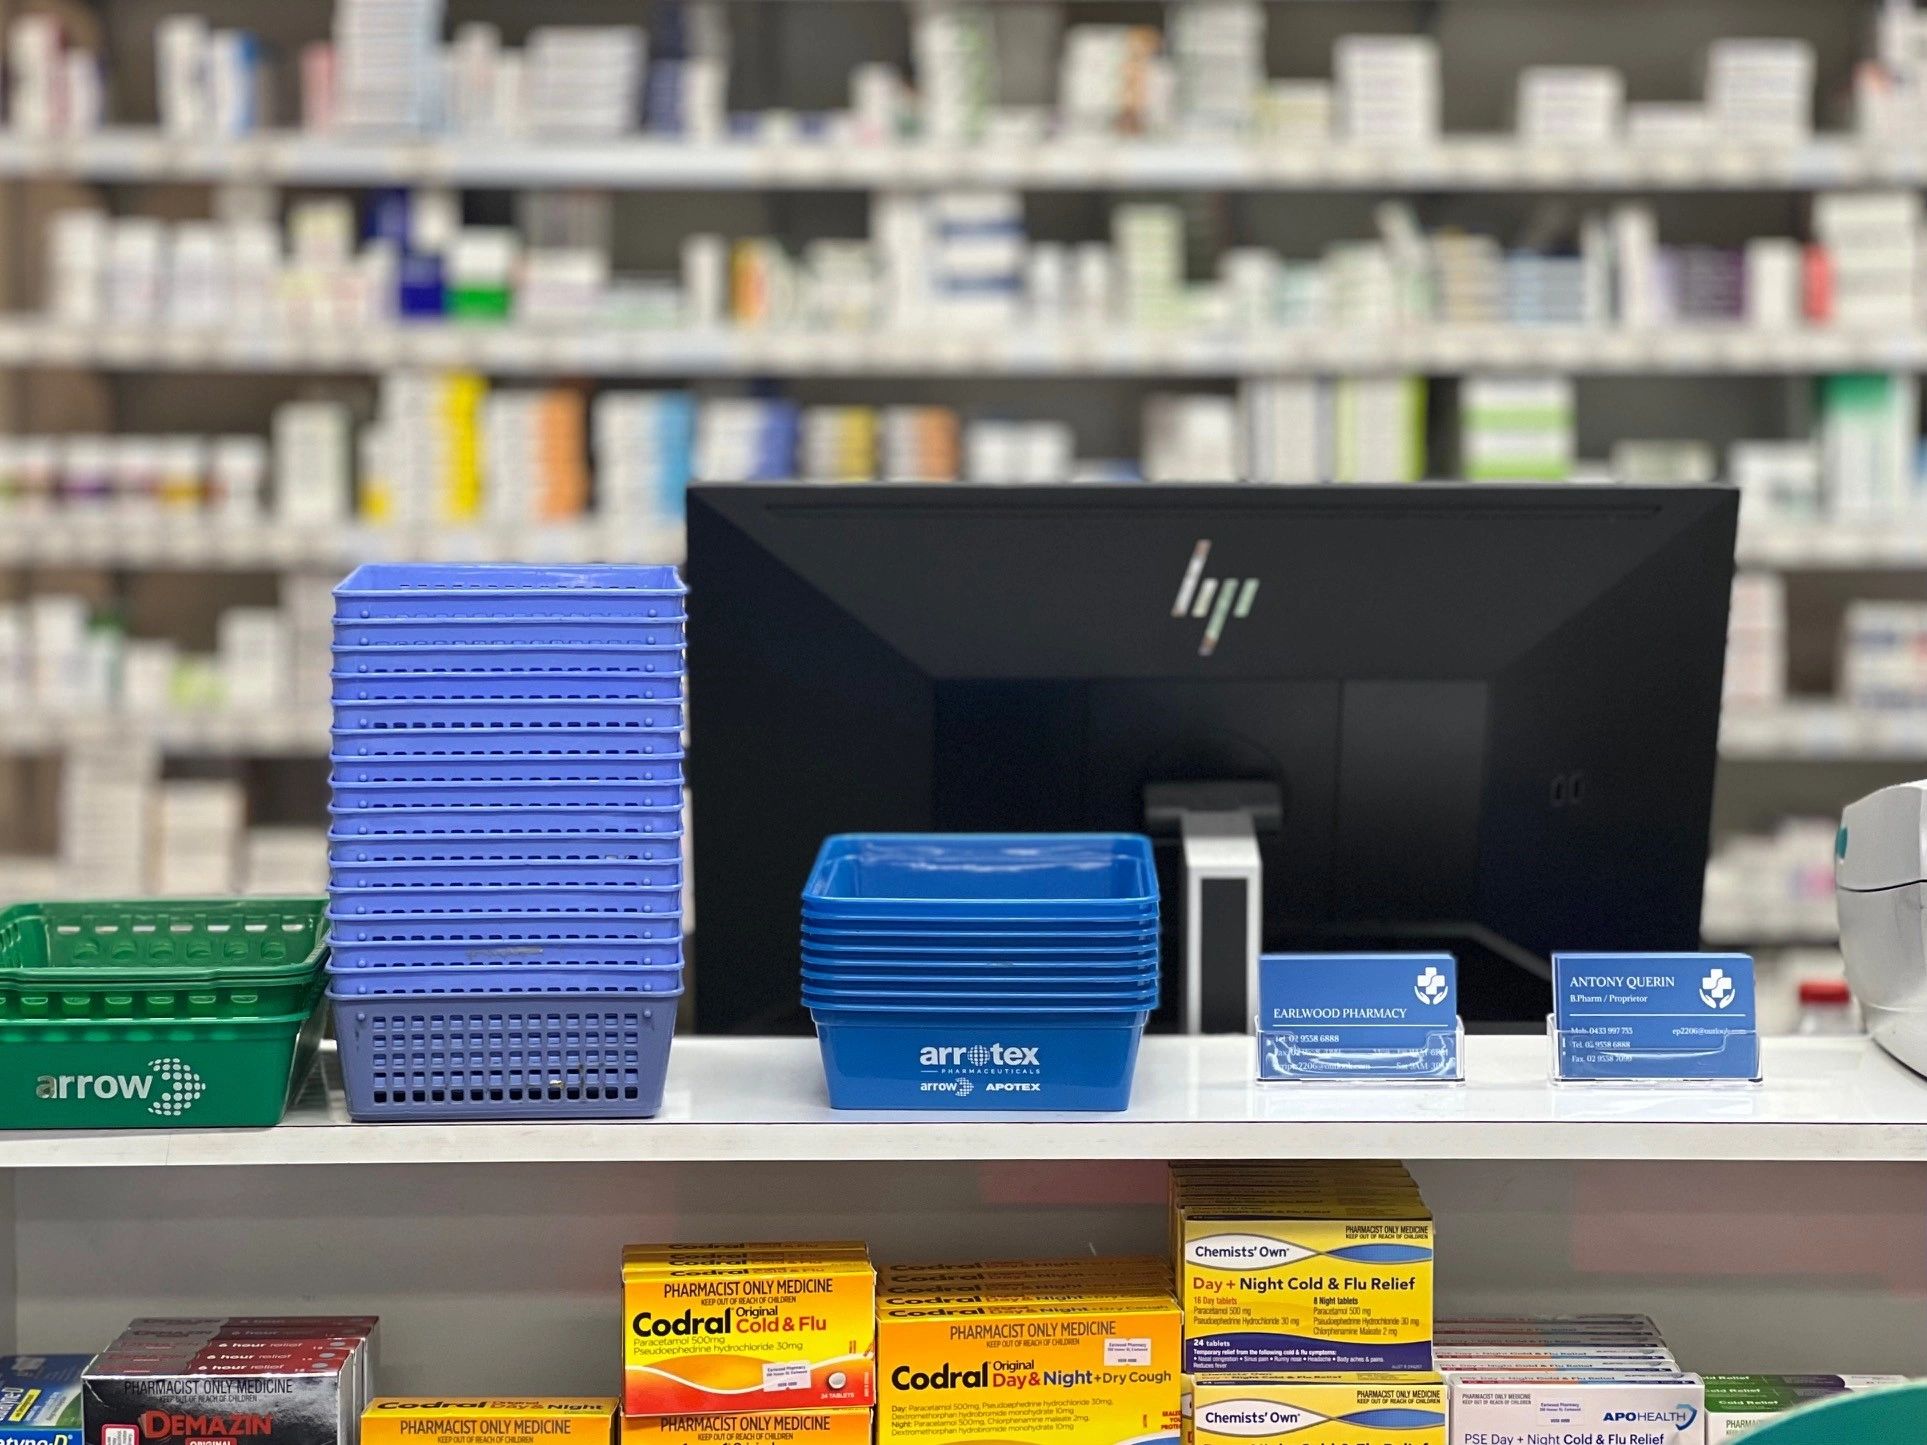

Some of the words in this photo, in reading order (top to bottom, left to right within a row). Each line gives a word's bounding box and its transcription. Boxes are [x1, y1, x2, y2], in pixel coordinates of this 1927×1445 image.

[1570, 976, 1624, 987] ANTONY
[1626, 976, 1675, 988] QUERIN
[1609, 994, 1648, 1004] Proprietor
[1273, 1008, 1340, 1019] EARLWOOD
[1342, 1008, 1407, 1019] PHARMACY
[1300, 1034, 1319, 1043] 9558
[1320, 1034, 1340, 1043] 6888
[920, 1043, 1040, 1066] arrotex
[36, 1075, 153, 1099] arrow
[920, 1082, 957, 1091] arrow
[985, 1083, 1040, 1091] APOTEX
[1345, 1225, 1383, 1233] PHARMACIST
[1384, 1225, 1399, 1233] ONLY
[1400, 1225, 1428, 1233] MEDICINE
[1195, 1246, 1257, 1258] Chemists'
[664, 1281, 740, 1298] PHARMACIST
[743, 1280, 773, 1295] ONLY
[776, 1278, 833, 1293] MEDICINE
[1193, 1278, 1223, 1293] Day
[1226, 1280, 1236, 1289] +
[1240, 1277, 1284, 1293] Night
[1288, 1276, 1323, 1290] Cold
[1327, 1277, 1340, 1290] &
[1344, 1276, 1368, 1290] Flu
[1371, 1276, 1416, 1290] Relief
[701, 1298, 716, 1306] KEEP
[767, 1296, 796, 1304] CHILDREN
[1203, 1297, 1214, 1305] Day
[1319, 1297, 1336, 1306] Night
[888, 1308, 985, 1316] Codral
[632, 1307, 731, 1337] Codral
[735, 1305, 778, 1318] Original
[736, 1317, 779, 1333] Cold
[782, 1317, 795, 1331] &
[799, 1316, 827, 1331] Flu
[950, 1323, 1025, 1340] PHARMACIST
[1027, 1322, 1058, 1338] ONLY
[1060, 1321, 1116, 1337] MEDICINE
[633, 1336, 689, 1347] Paracetamol
[692, 1336, 725, 1346] 500mg
[633, 1344, 711, 1356] Pseudoephedrine
[713, 1342, 774, 1353] hydrochloride
[776, 1341, 803, 1351] 30mg
[892, 1360, 988, 1390] Codral
[993, 1360, 1035, 1372] Original
[993, 1373, 1025, 1389] Day
[1043, 1371, 1093, 1388] Night
[1129, 1371, 1172, 1386] Cough
[125, 1380, 200, 1395] PHARMACIST
[204, 1380, 237, 1394] ONLY
[237, 1379, 293, 1394] MEDICINE
[1356, 1390, 1395, 1398] PHARMACIST
[1396, 1390, 1411, 1398] ONLY
[1412, 1390, 1440, 1398] MEDICINE
[378, 1401, 488, 1409] Codral
[1205, 1412, 1268, 1423] Chemists'
[1603, 1412, 1686, 1421] APOHEALTH
[144, 1409, 273, 1438] DEMAZIN
[400, 1420, 477, 1434] PHARMACIST
[480, 1420, 511, 1434] ONLY
[514, 1420, 571, 1434] MEDICINE
[661, 1417, 737, 1432] PHARMACIST
[740, 1417, 771, 1431] ONLY
[774, 1416, 831, 1430] MEDICINE
[765, 1432, 793, 1440] CHILDREN
[1464, 1434, 1487, 1445] PSE
[1491, 1434, 1514, 1445] Day
[1527, 1433, 1560, 1445] Night
[1563, 1434, 1592, 1445] Cold
[1596, 1434, 1605, 1445] &
[1608, 1434, 1626, 1445] Flu
[1630, 1434, 1664, 1445] Relief
